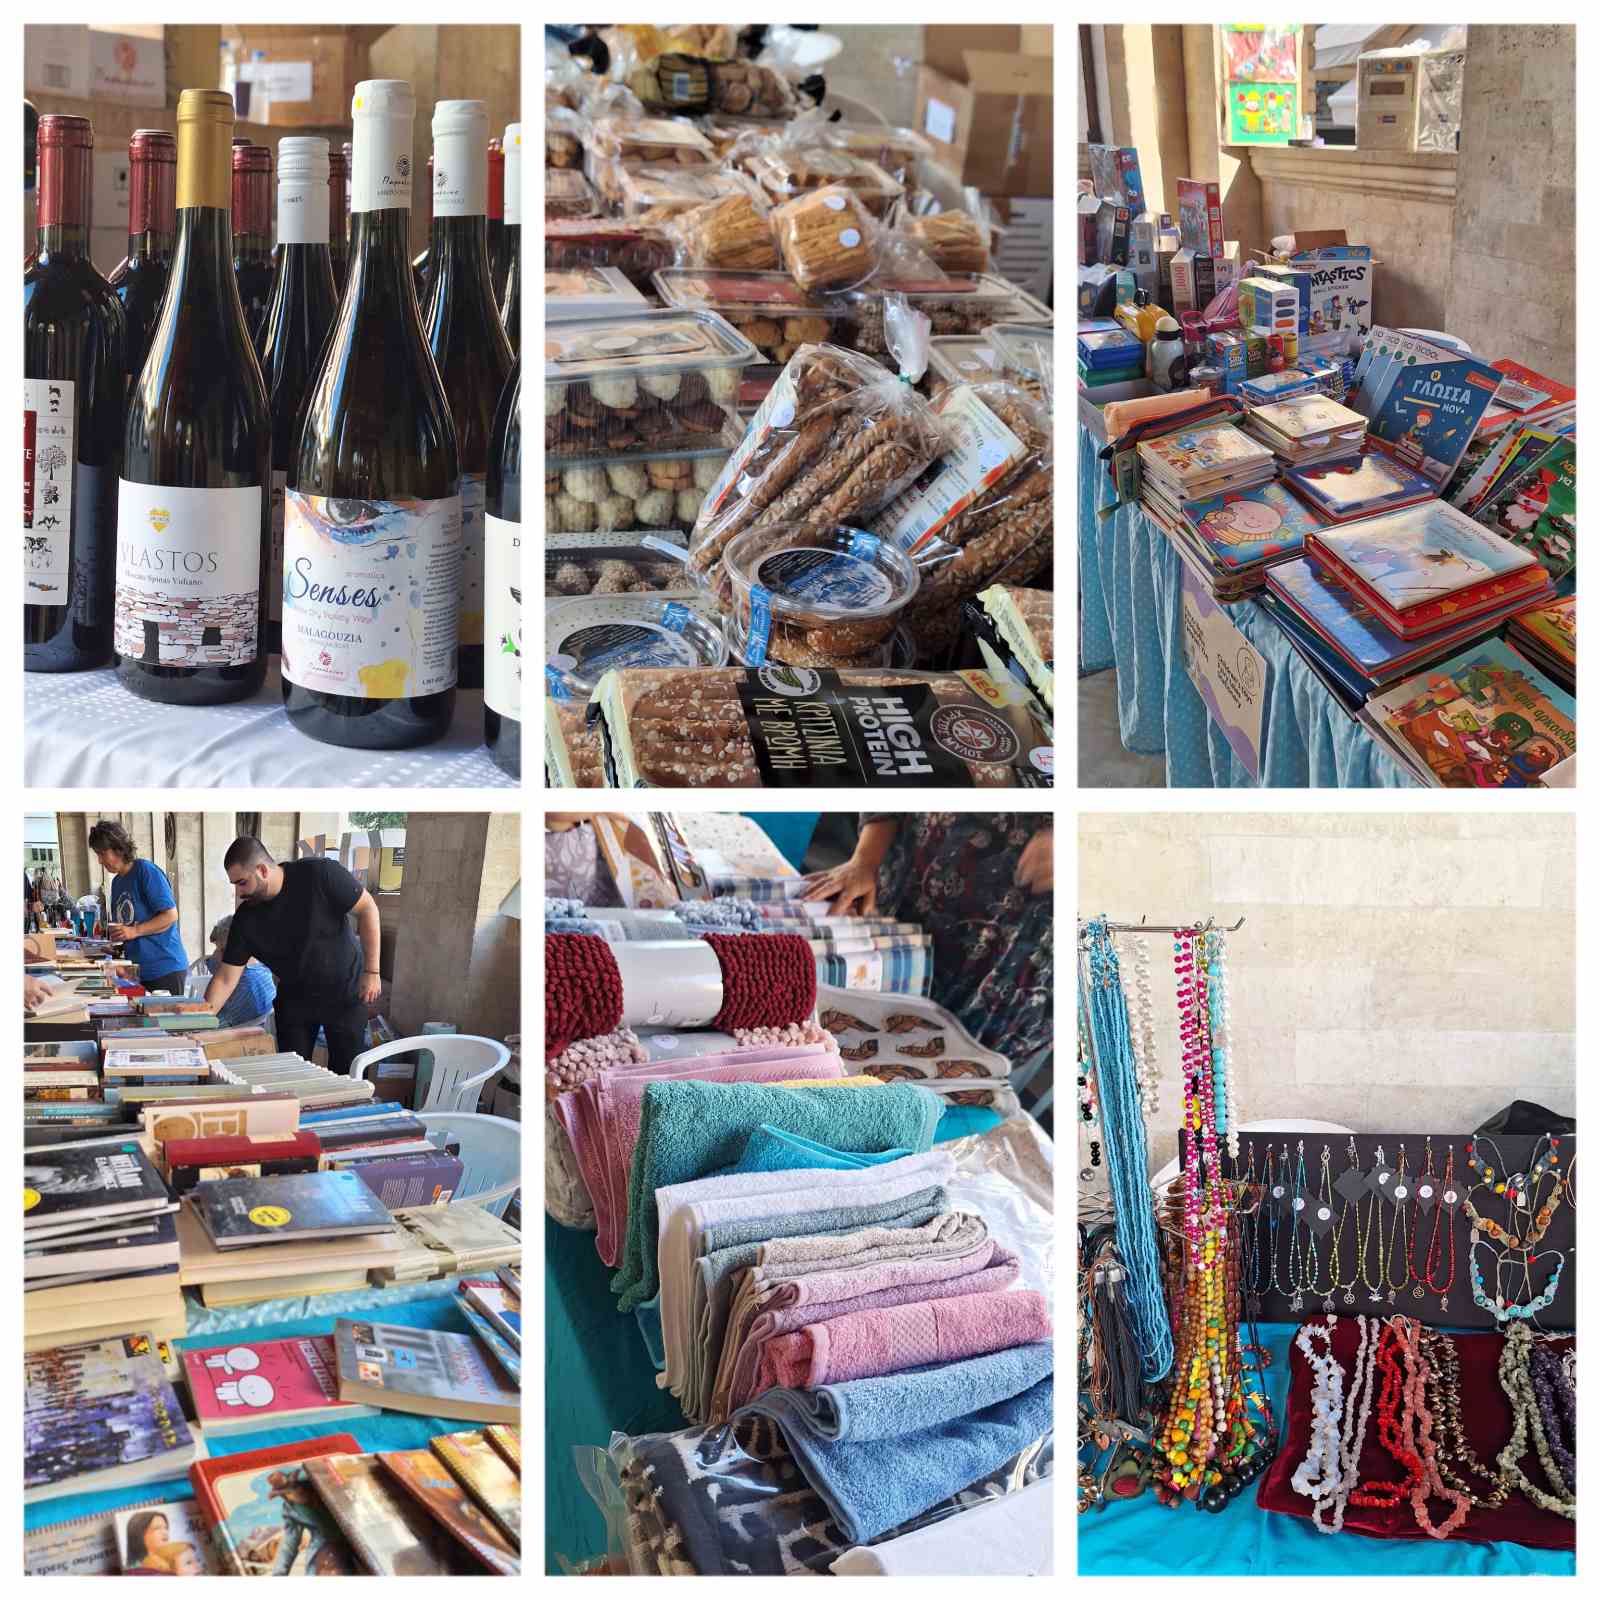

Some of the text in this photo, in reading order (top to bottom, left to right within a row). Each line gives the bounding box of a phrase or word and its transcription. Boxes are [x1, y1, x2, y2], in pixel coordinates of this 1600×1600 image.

[1311, 266, 1366, 287] NTASTICS
[1411, 379, 1471, 405] ΓΛΩΣΣΑ
[287, 556, 382, 608] Senses
[751, 697, 809, 770] ΜΕ ΒΡΩΜΗ
[793, 701, 848, 766] ΚΡΙΤΣΙΝΙΑ
[848, 696, 899, 776] PROTEIN
[871, 696, 935, 775] HIGH
